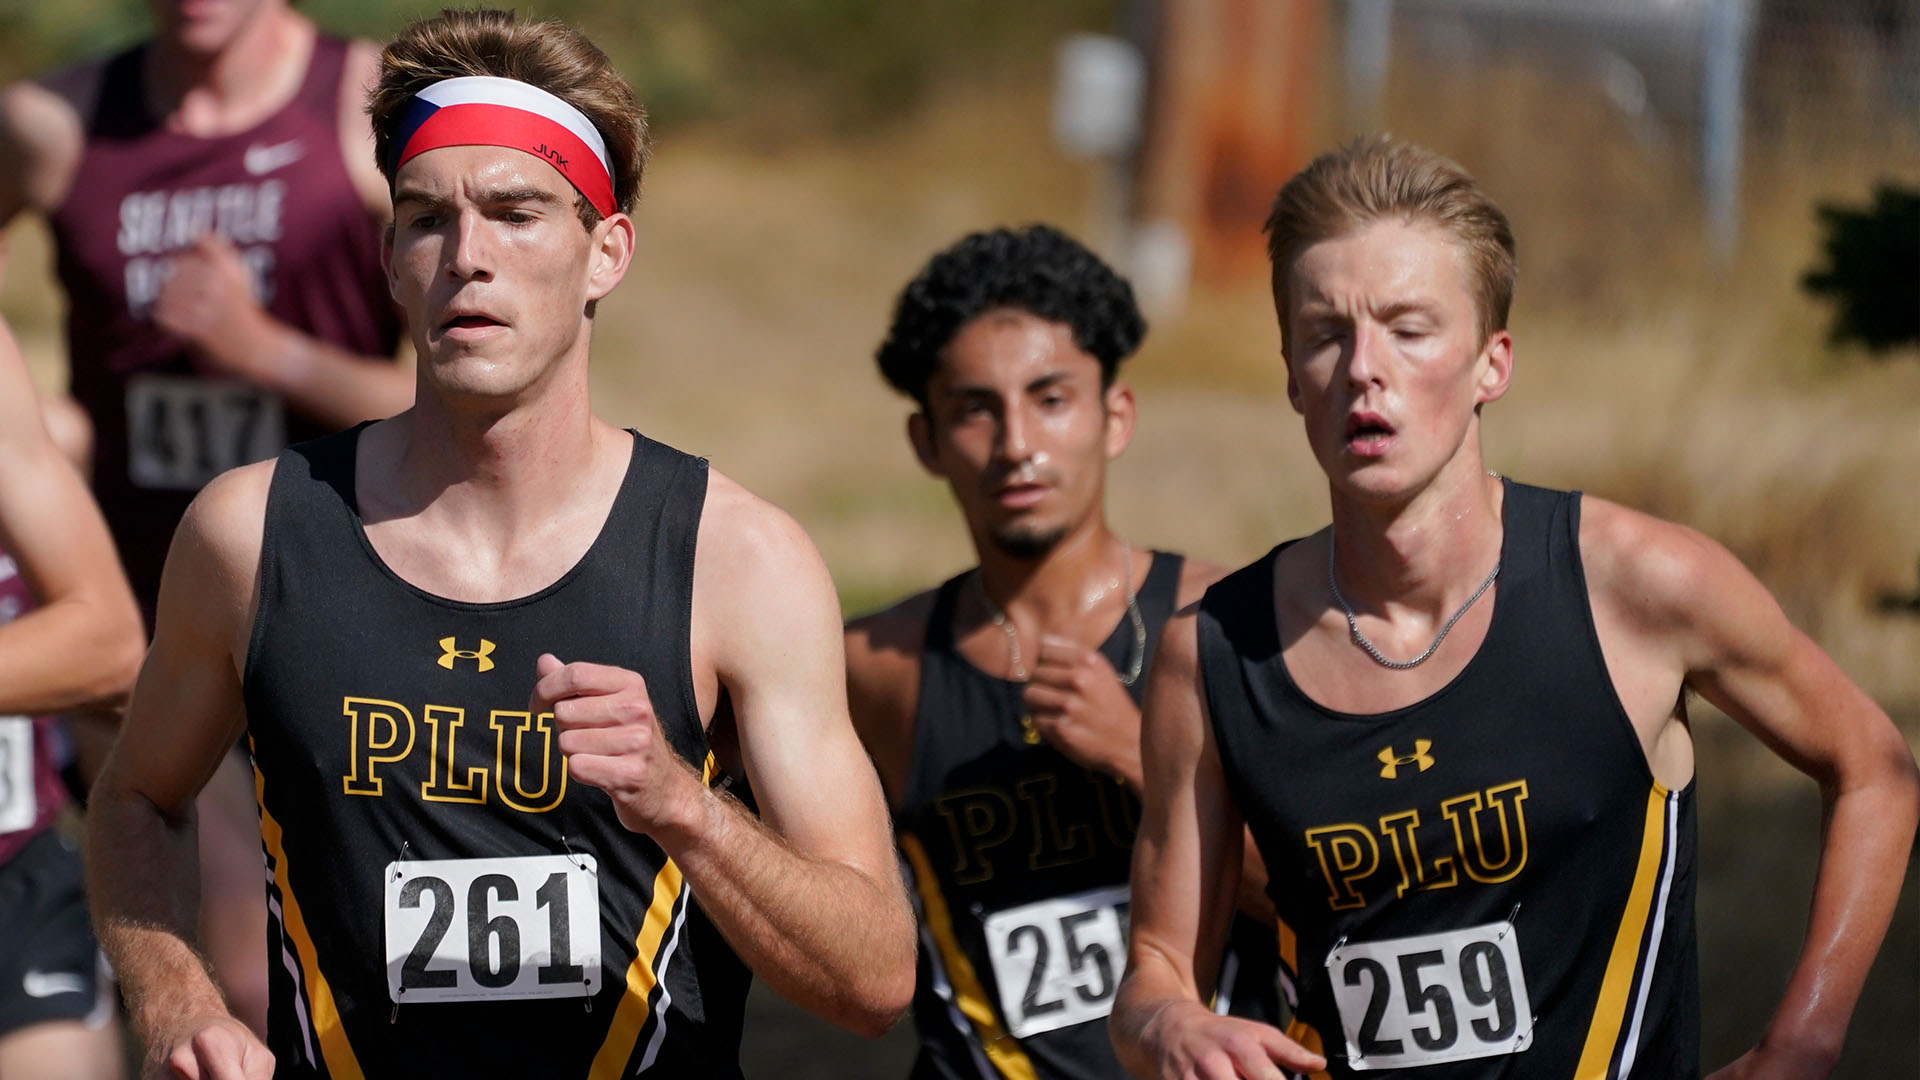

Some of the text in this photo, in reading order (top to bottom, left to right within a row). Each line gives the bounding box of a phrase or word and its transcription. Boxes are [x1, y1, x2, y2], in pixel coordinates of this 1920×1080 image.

[532, 143, 569, 172] JUNK
[342, 696, 569, 814] PLU
[1304, 778, 1530, 912] PLU
[398, 872, 585, 989] 261
[1007, 902, 1131, 1018] 25
[1343, 940, 1518, 1056] 259
